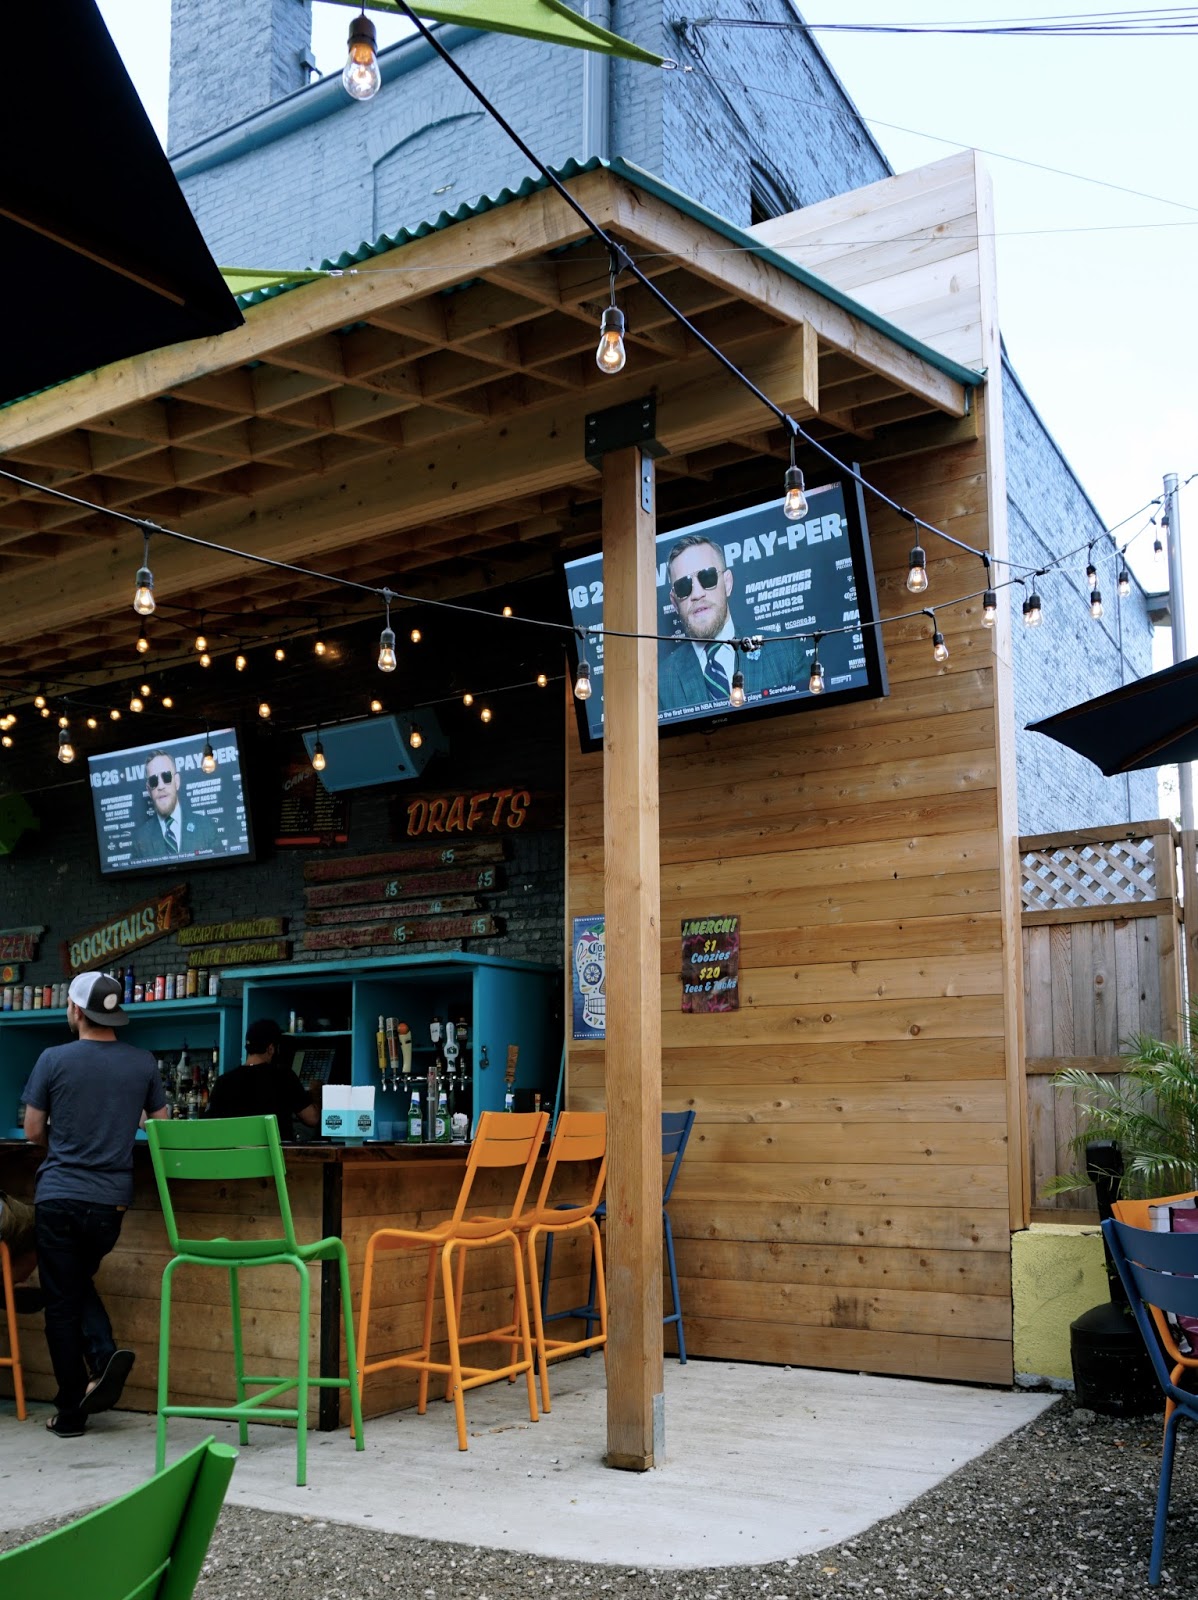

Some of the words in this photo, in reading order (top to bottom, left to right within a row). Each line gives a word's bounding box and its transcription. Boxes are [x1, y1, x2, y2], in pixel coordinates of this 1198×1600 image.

[745, 568, 812, 594] MAYWEATHER
[757, 580, 812, 602] McGREGOR
[753, 602, 771, 615] SAT
[769, 684, 797, 695] ScoreGuide
[700, 702, 713, 710] NBA
[713, 699, 731, 709] history
[747, 693, 762, 702] playe
[125, 764, 146, 782] LIV
[406, 788, 531, 836] DRAFTS
[441, 848, 455, 864] $5
[478, 870, 493, 889] $5
[385, 881, 398, 897] $5
[393, 925, 406, 942] $5
[473, 918, 487, 935] $5
[70, 906, 156, 968] COCKTAILS
[703, 939, 717, 953] $1
[691, 950, 731, 964] Coozies
[699, 966, 721, 980] $20
[685, 983, 704, 993] Tees
[704, 981, 712, 992] &
